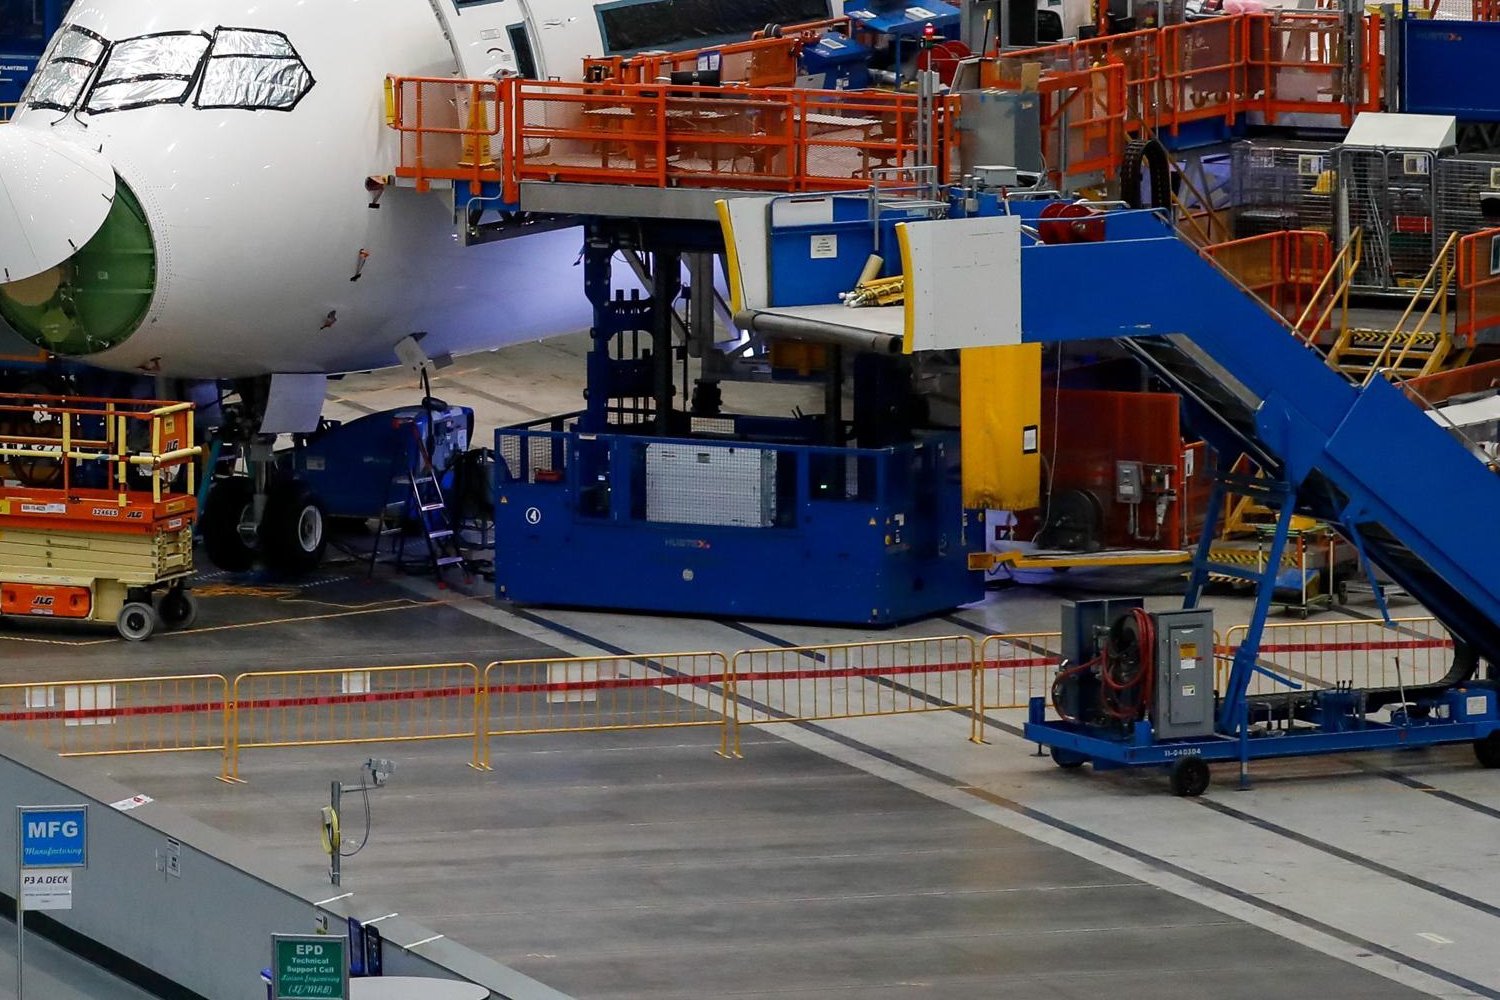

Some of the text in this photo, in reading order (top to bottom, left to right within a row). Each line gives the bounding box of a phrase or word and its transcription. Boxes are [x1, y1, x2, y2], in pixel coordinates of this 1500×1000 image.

[127, 510, 143, 519] JLG
[32, 595, 53, 605] JLG
[28, 820, 79, 839] MFG
[24, 876, 69, 885] P3 A DECK
[296, 944, 324, 956] EPD
[292, 957, 330, 965] Technical
[286, 966, 318, 974] Support
